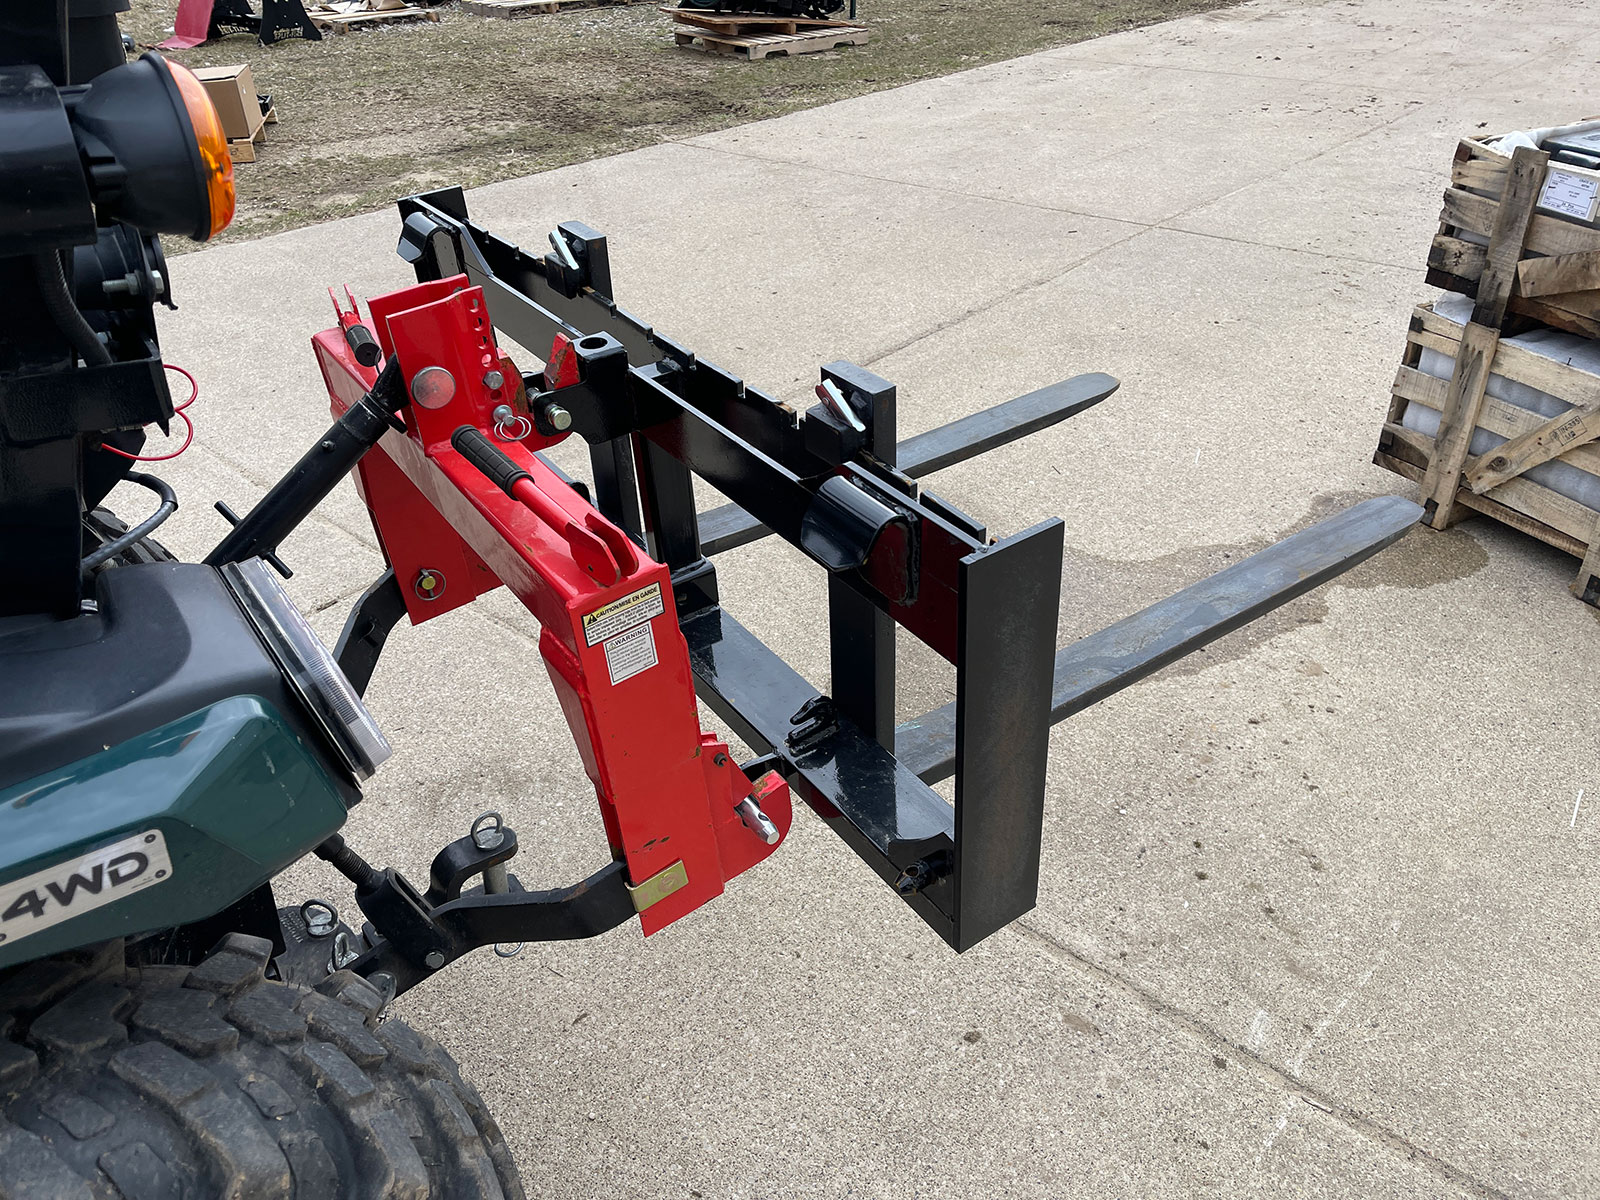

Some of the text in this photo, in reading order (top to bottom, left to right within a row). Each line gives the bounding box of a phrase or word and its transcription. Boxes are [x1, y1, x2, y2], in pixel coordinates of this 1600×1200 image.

[640, 586, 658, 599] GARDE
[615, 627, 648, 646] WARNING
[1, 852, 149, 922] 4WD
